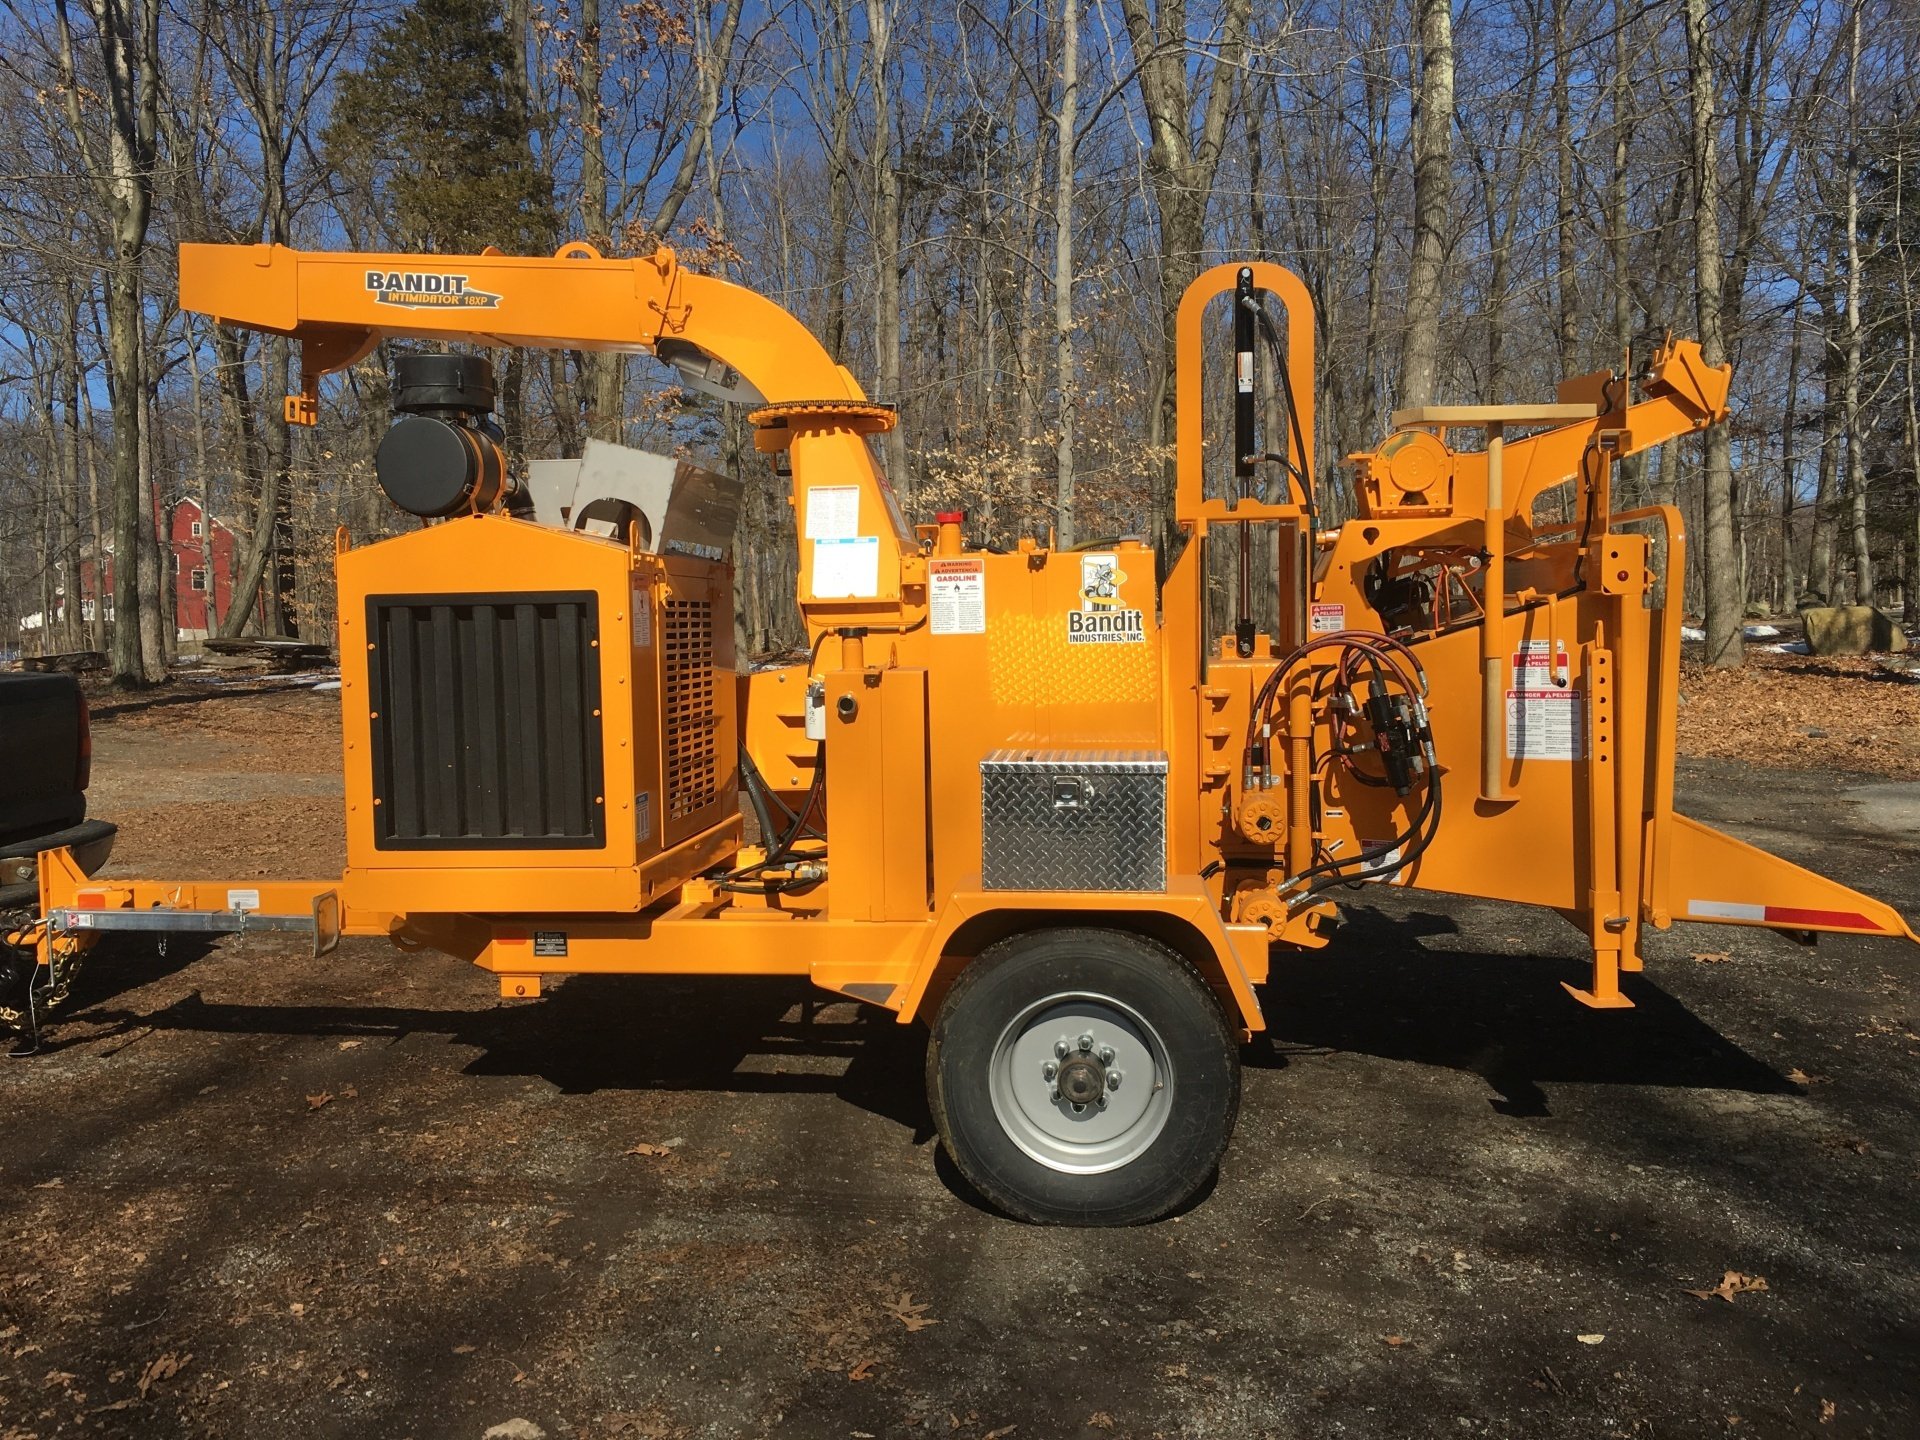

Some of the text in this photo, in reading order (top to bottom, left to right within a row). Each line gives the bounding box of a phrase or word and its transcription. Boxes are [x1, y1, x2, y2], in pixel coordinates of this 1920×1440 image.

[366, 271, 468, 294] BANDIT
[464, 296, 488, 306] 18XP
[936, 574, 977, 582] GASOLINE
[1069, 610, 1142, 633] Bandit
[1069, 632, 1145, 643] INDUSTRIES, INC.
